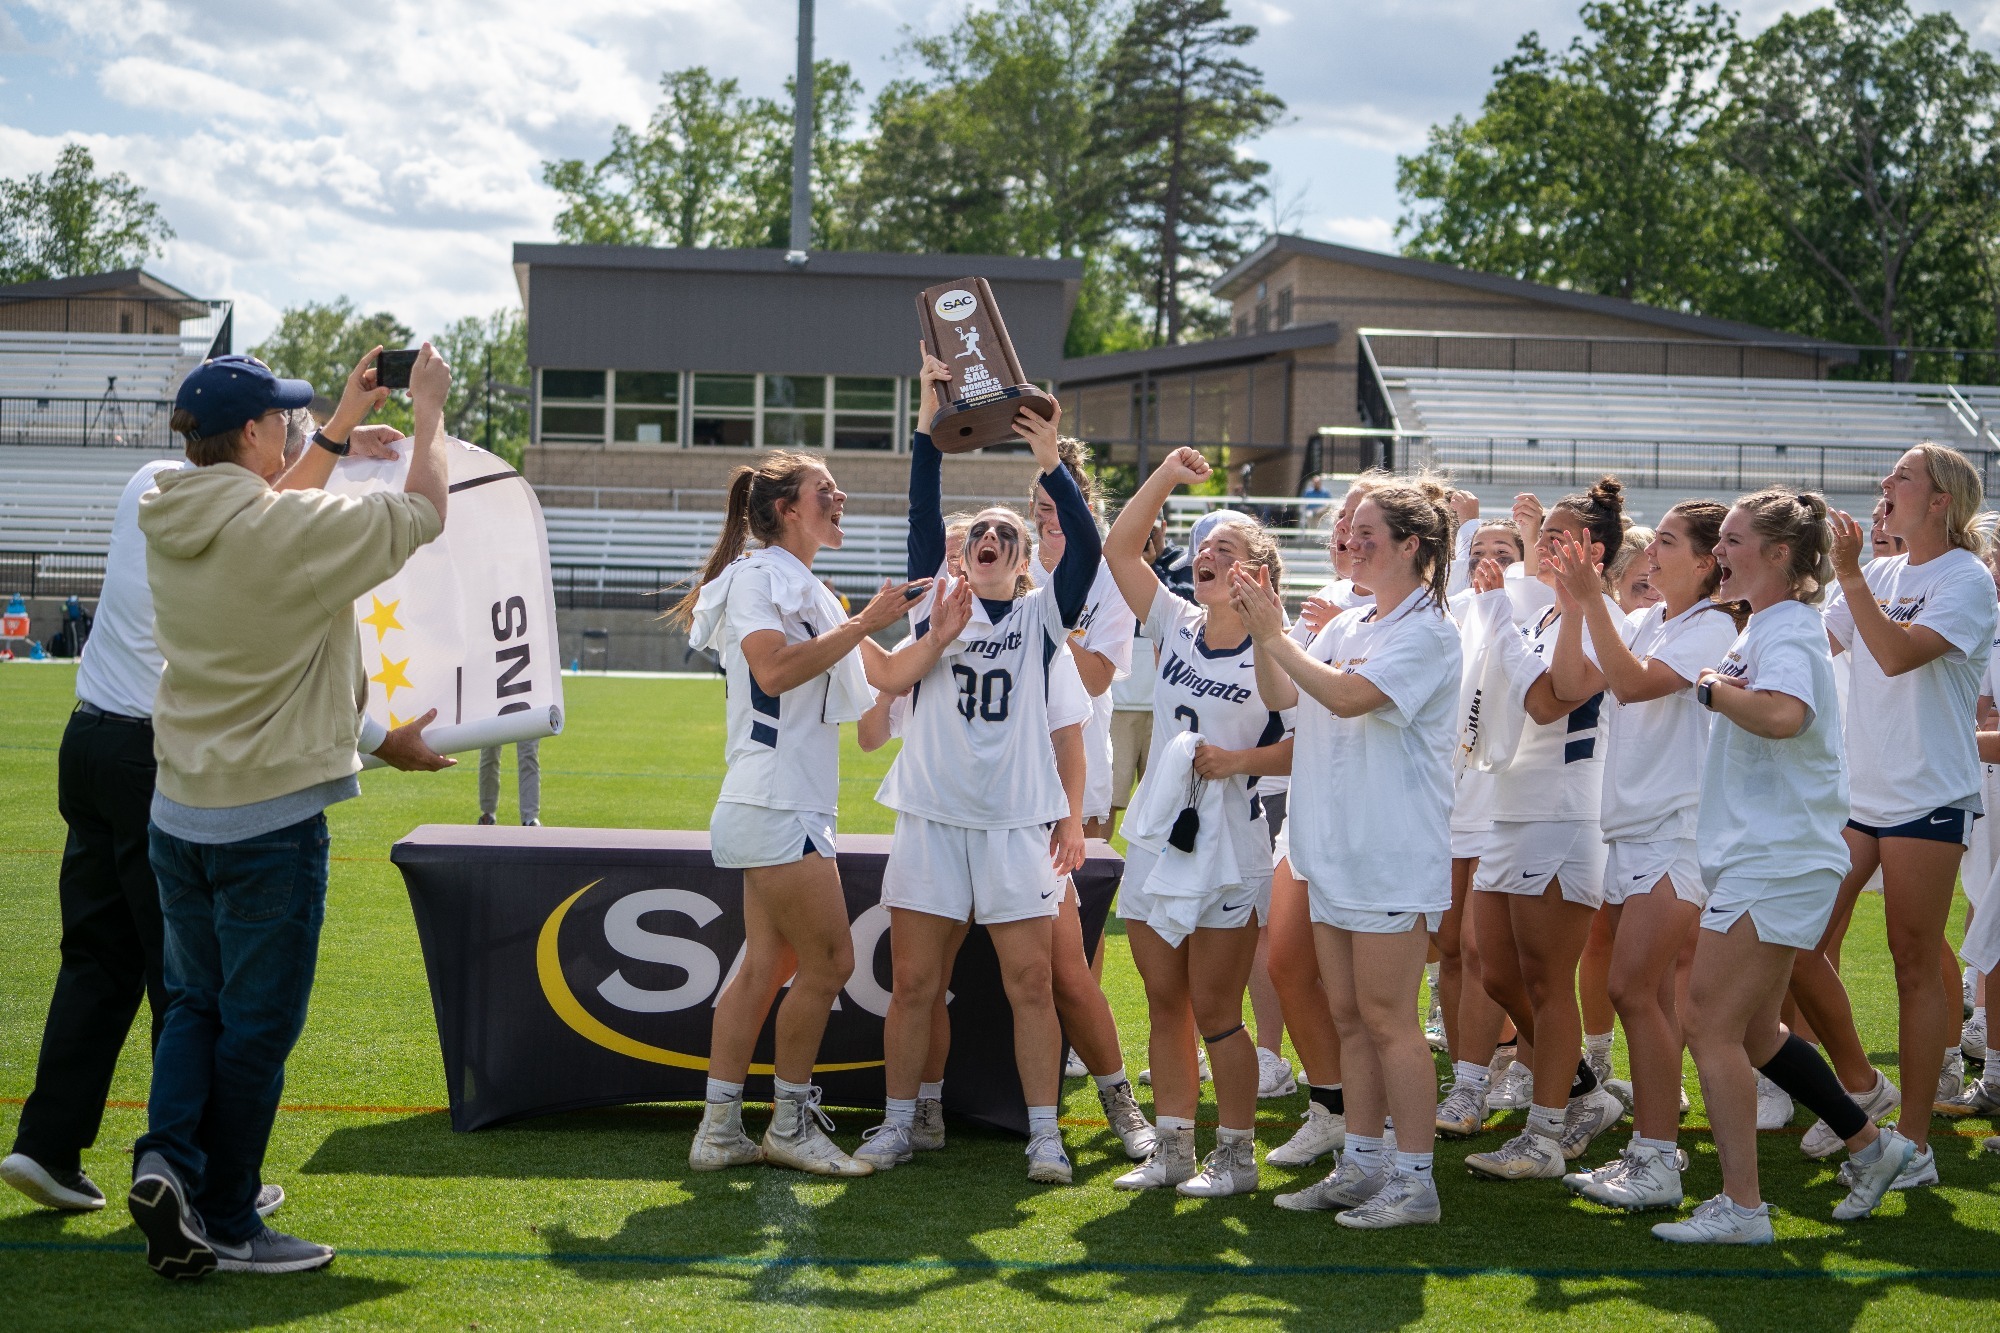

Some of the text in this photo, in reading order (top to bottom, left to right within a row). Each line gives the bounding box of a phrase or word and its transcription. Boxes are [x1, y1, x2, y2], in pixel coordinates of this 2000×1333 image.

[943, 296, 973, 311] SAC
[964, 363, 985, 374] 2023
[963, 369, 990, 384] SAC
[959, 377, 1000, 393] WOMEN'S
[1162, 648, 1252, 704] Wingate
[596, 889, 955, 1018] SC
